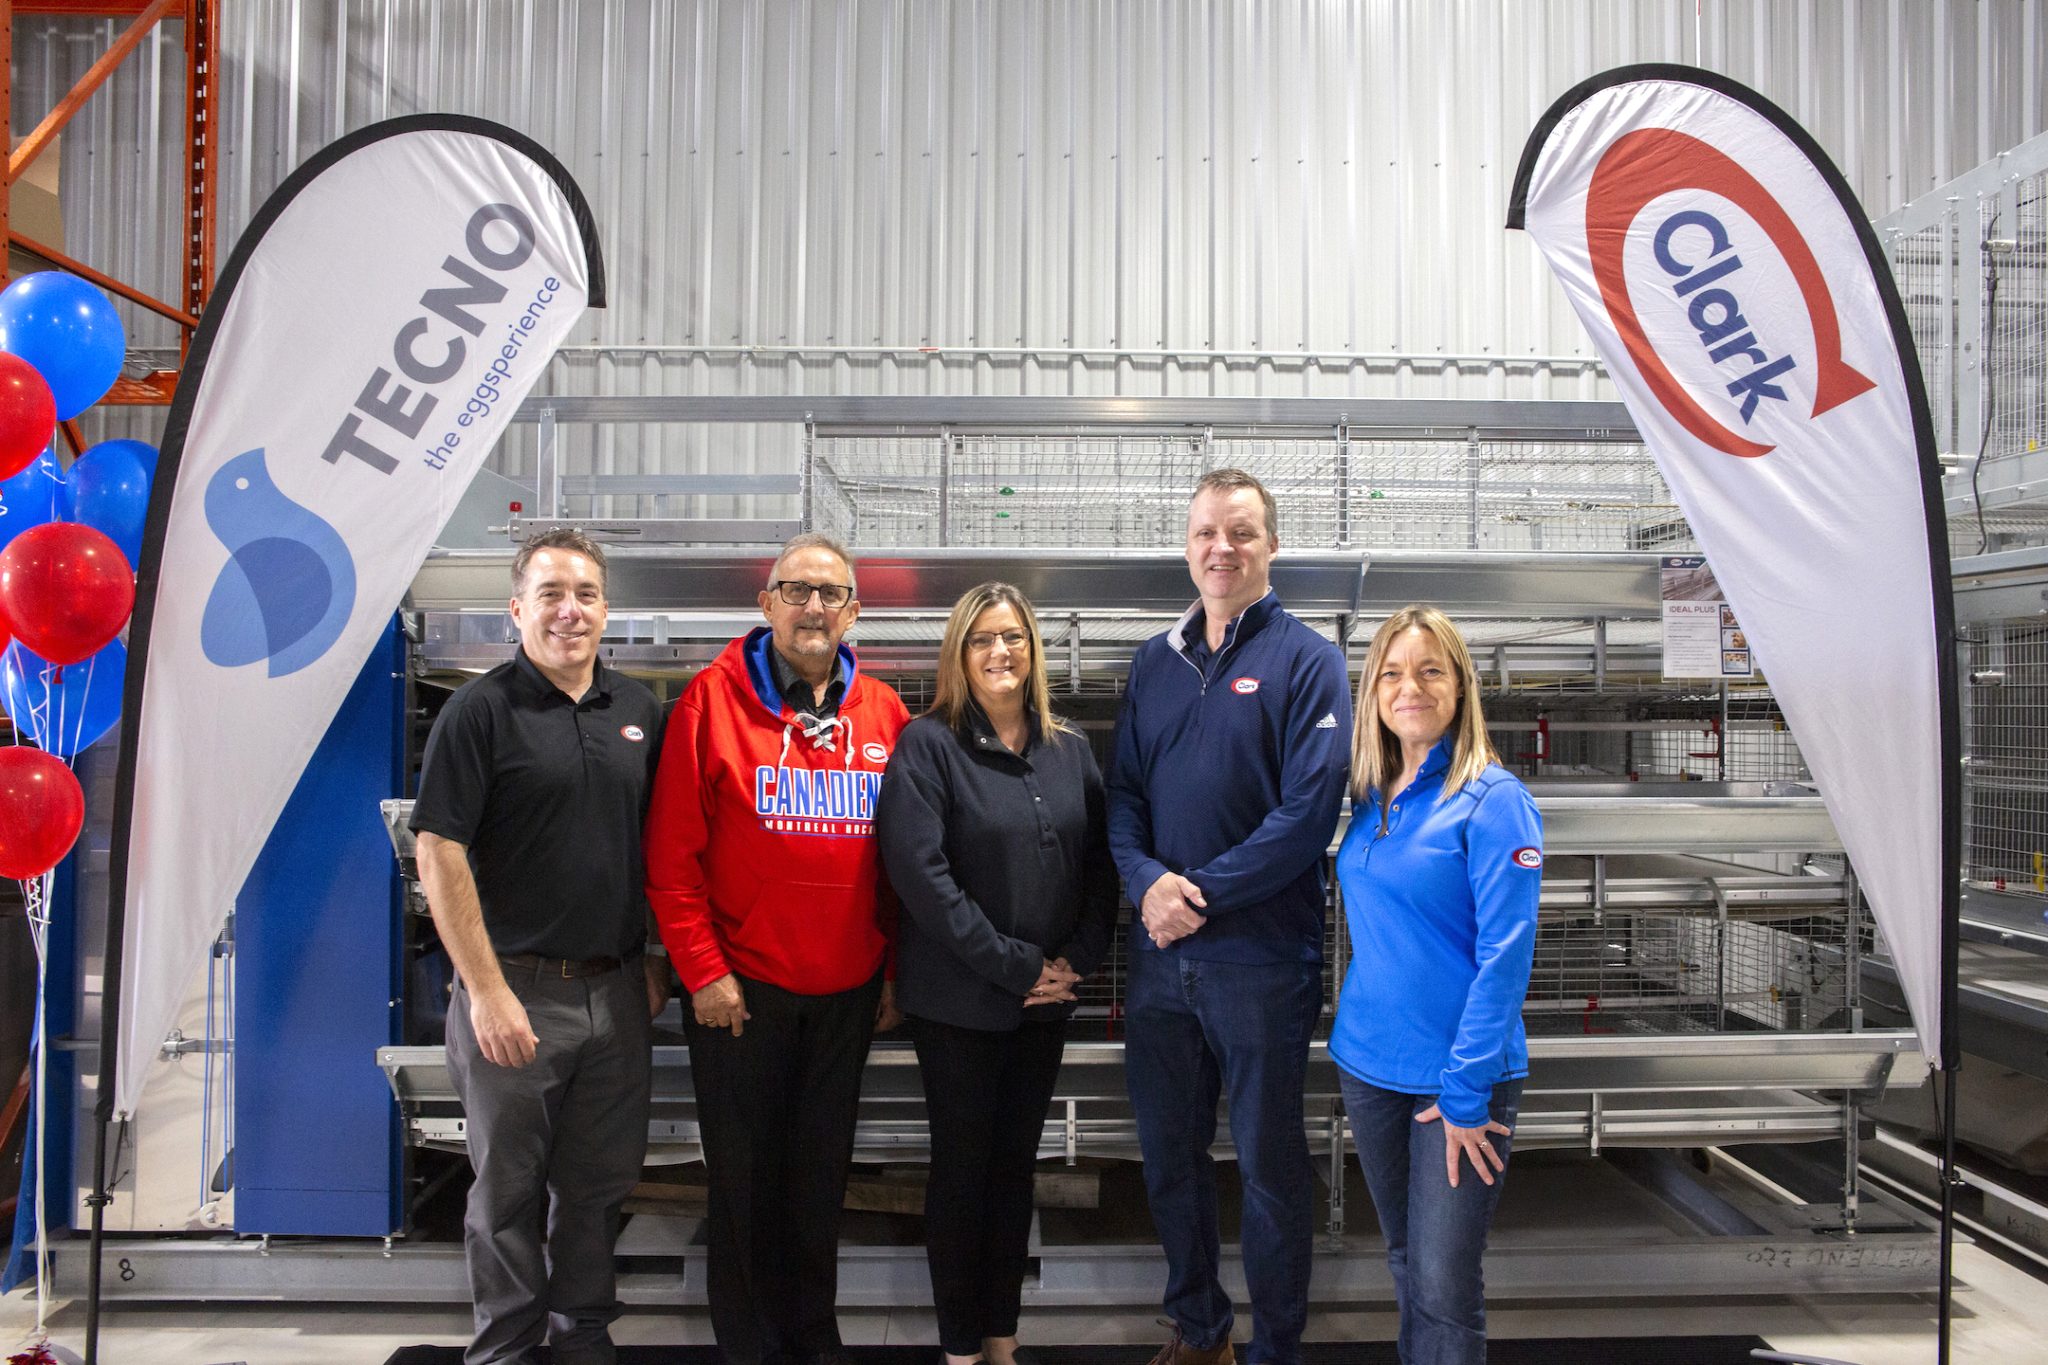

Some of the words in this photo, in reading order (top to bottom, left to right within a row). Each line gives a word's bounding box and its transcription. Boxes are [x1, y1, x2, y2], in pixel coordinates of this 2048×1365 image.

[321, 203, 535, 475] TECNO
[1653, 210, 1796, 426] Clark
[424, 432, 460, 471] the
[457, 275, 561, 427] eggsperience
[1669, 605, 1692, 613] IDEAL
[1694, 605, 1716, 613] PLUS
[756, 765, 884, 820] CANADIEN
[764, 820, 836, 833] MONTREAL
[119, 1258, 135, 1281] 8
